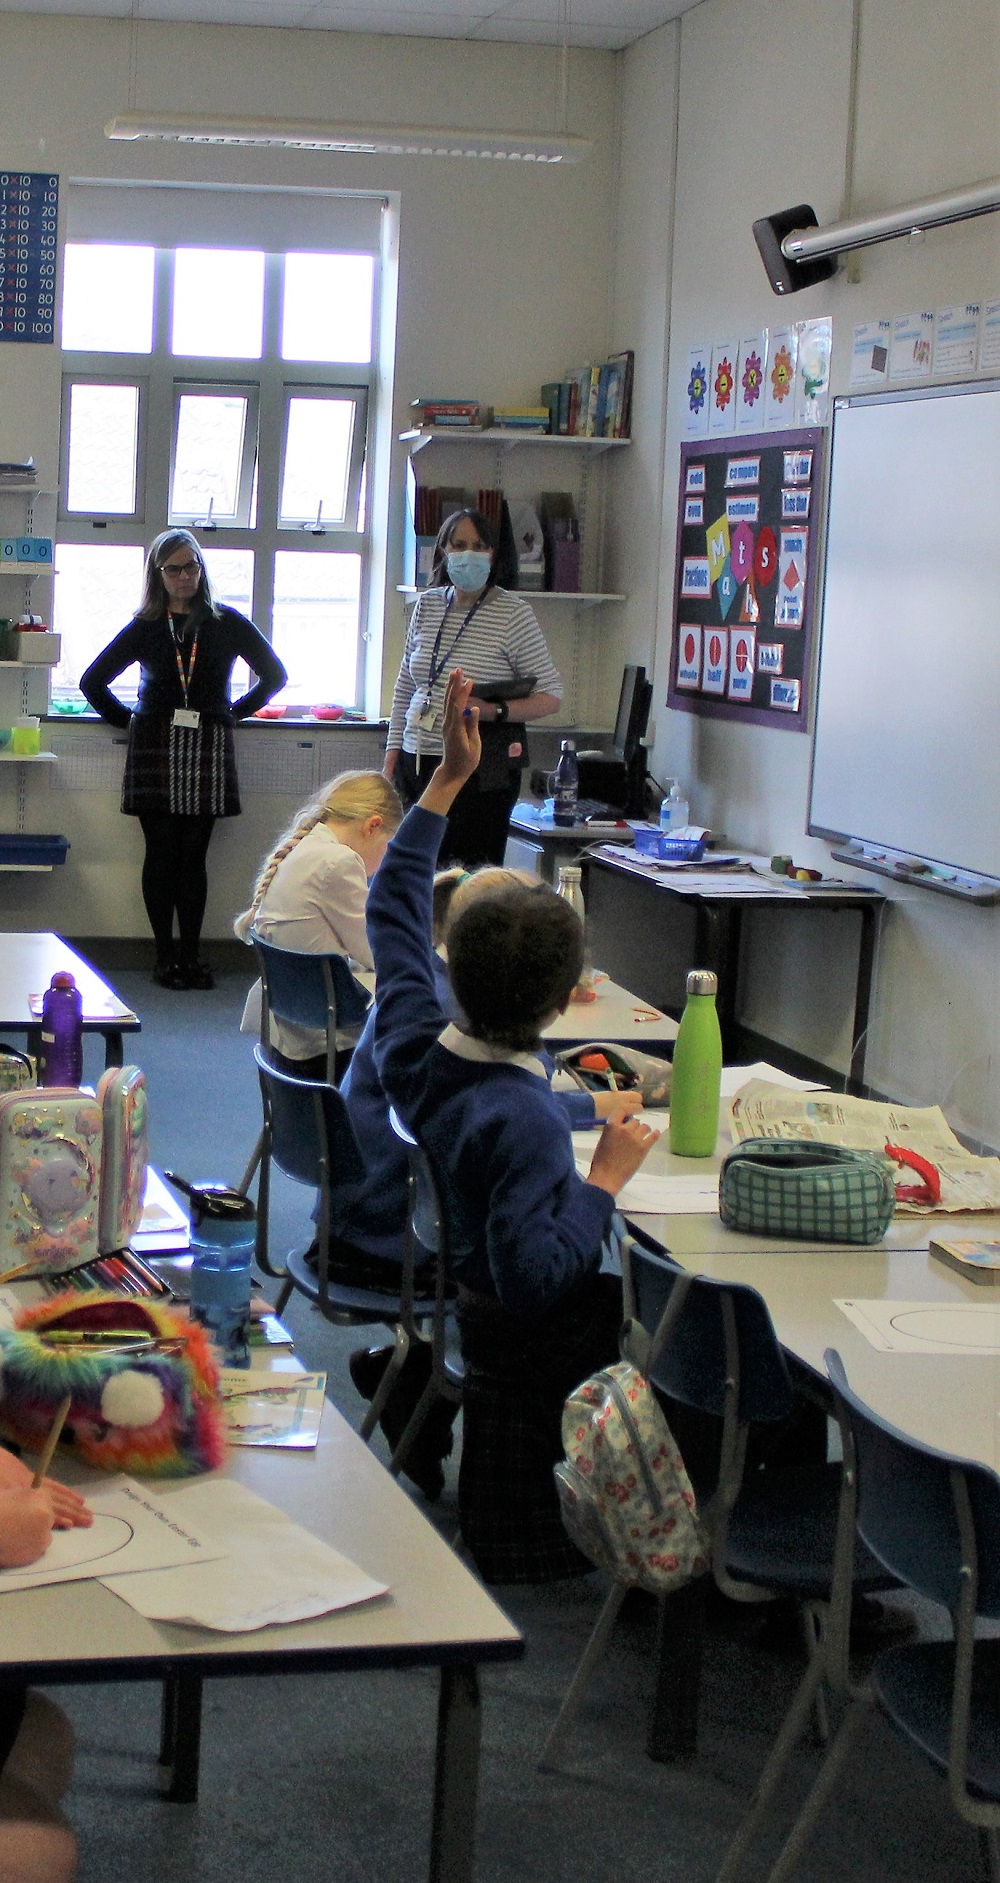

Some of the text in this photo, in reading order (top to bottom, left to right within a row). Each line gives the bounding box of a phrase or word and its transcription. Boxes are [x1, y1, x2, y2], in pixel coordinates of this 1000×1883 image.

[0, 174, 58, 187] 0 10 0
[18, 190, 31, 200] 10
[43, 192, 57, 202] 10
[0, 204, 57, 217] 2 10 20
[0, 218, 57, 231] 3 10 30
[0, 233, 56, 246] 4 10 40
[0, 247, 56, 260] 5 10 50
[15, 262, 28, 274] 10
[39, 263, 55, 275] 60
[15, 277, 28, 288] 10
[39, 278, 54, 289] 70
[15, 292, 27, 303] 10
[38, 293, 54, 304] 80
[14, 306, 27, 317] 10
[37, 307, 53, 318] 90
[13, 321, 26, 332] 10
[31, 323, 52, 333] 100
